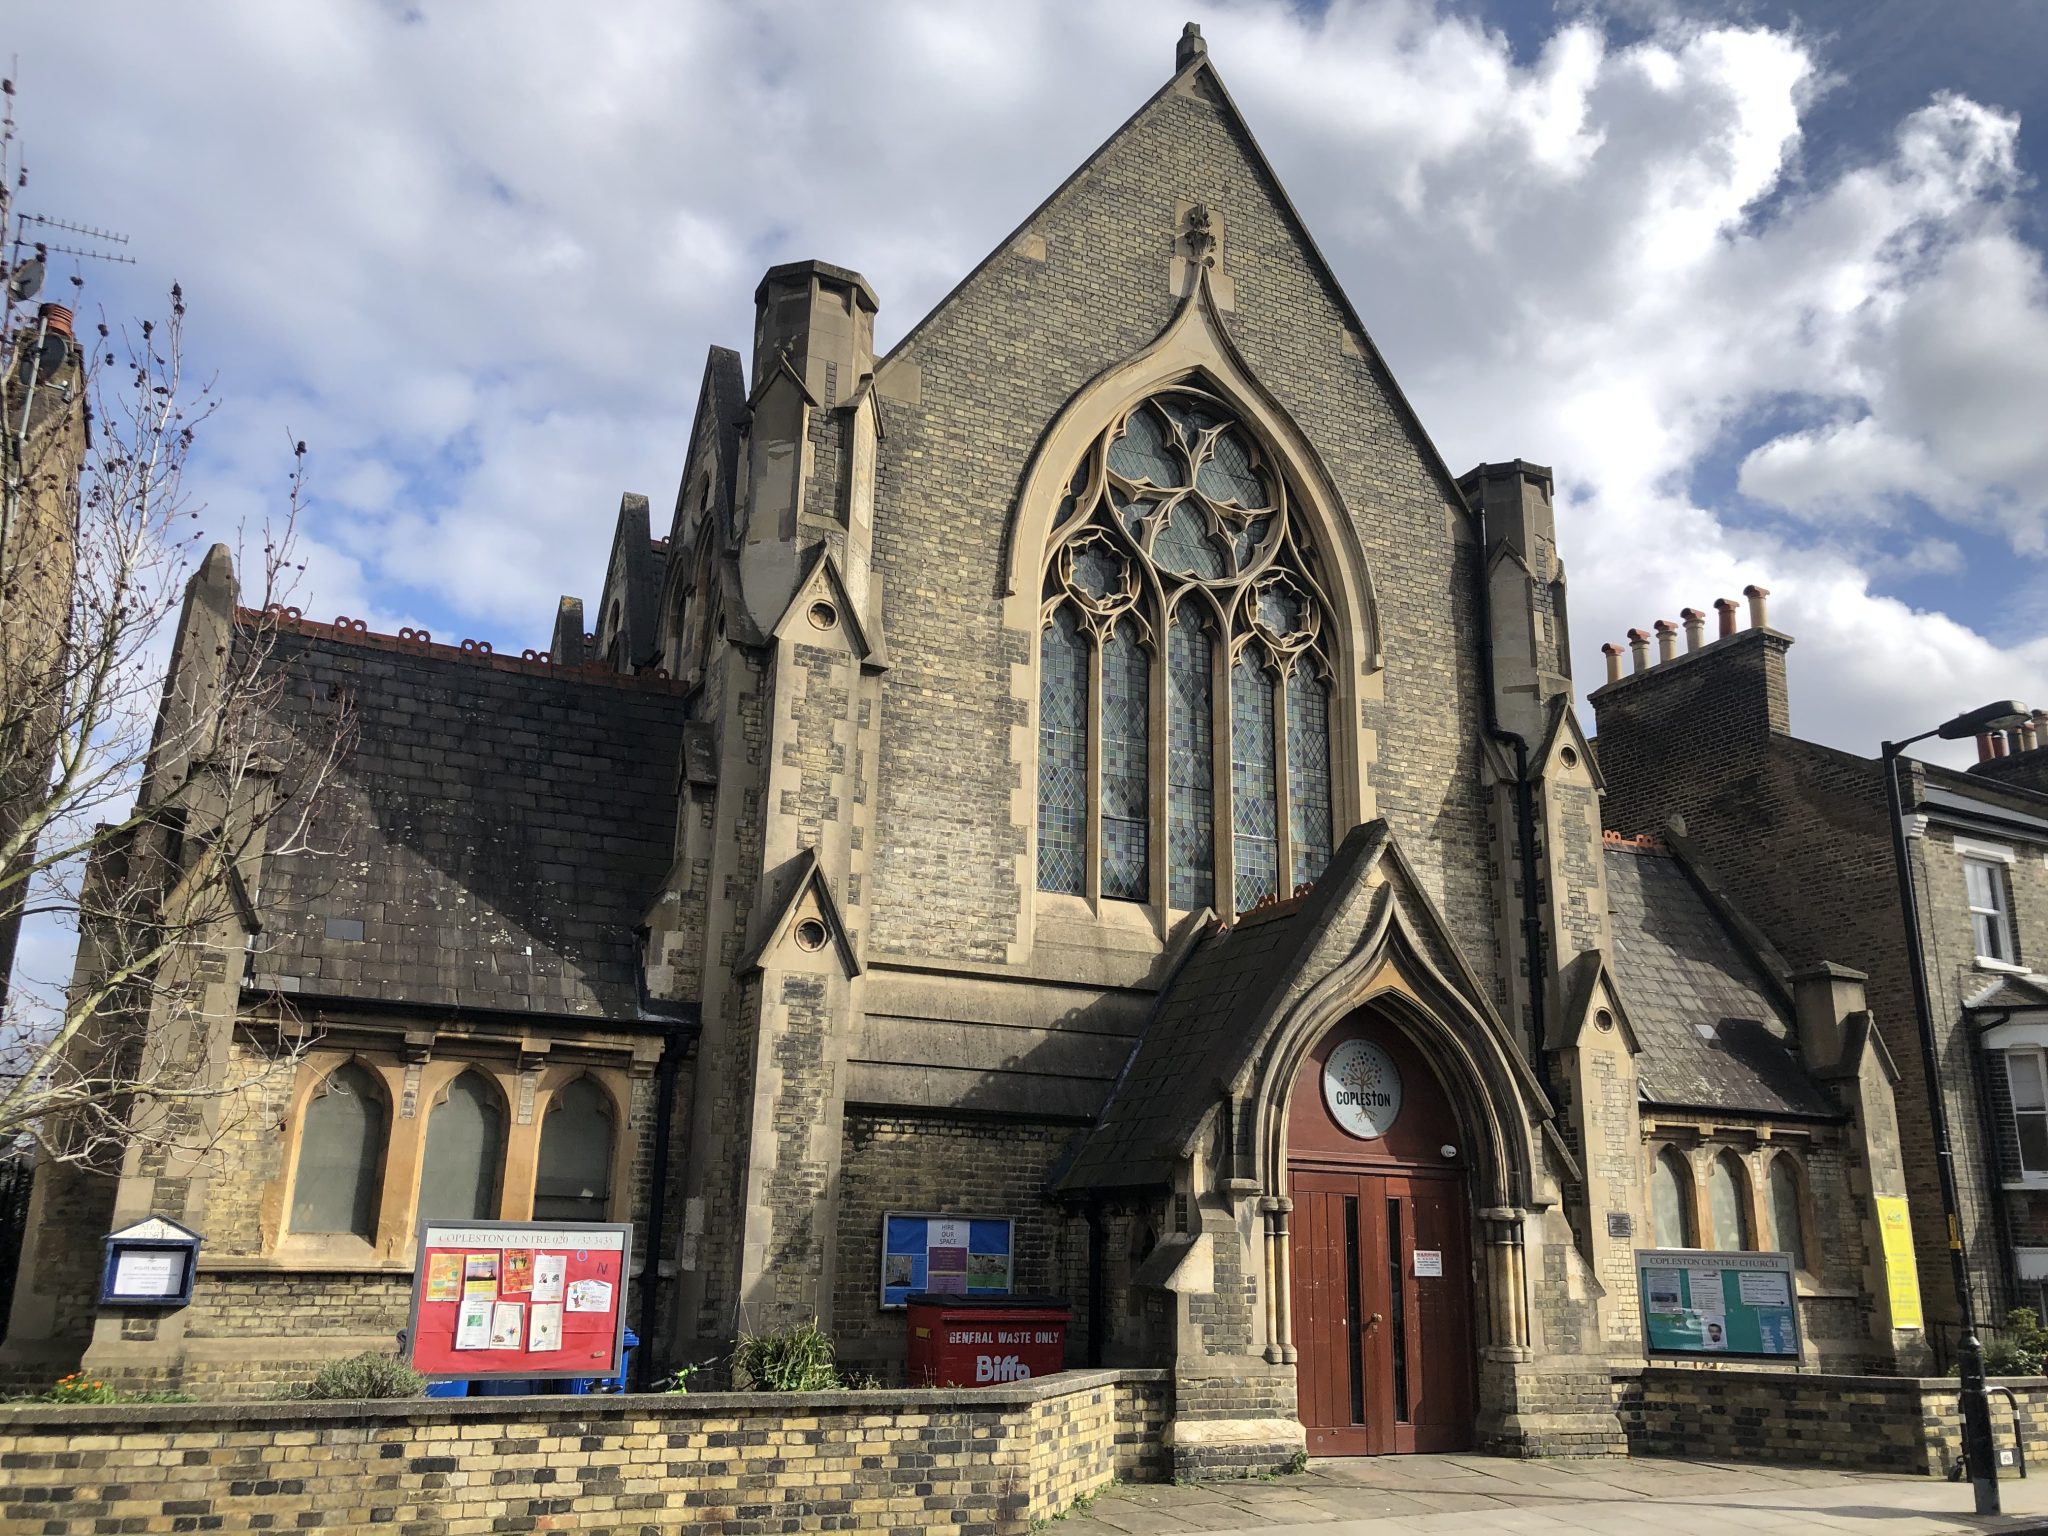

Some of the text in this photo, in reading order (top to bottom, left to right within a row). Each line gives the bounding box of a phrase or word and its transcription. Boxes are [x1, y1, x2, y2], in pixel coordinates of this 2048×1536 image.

[1336, 1090, 1391, 1107] COPLESTON
[440, 1233, 504, 1243] COPLESTON
[1649, 1257, 1778, 1268] COPLESTON CENTRE CHURCH
[949, 1331, 1059, 1344] GENERAL WASTE ONLY
